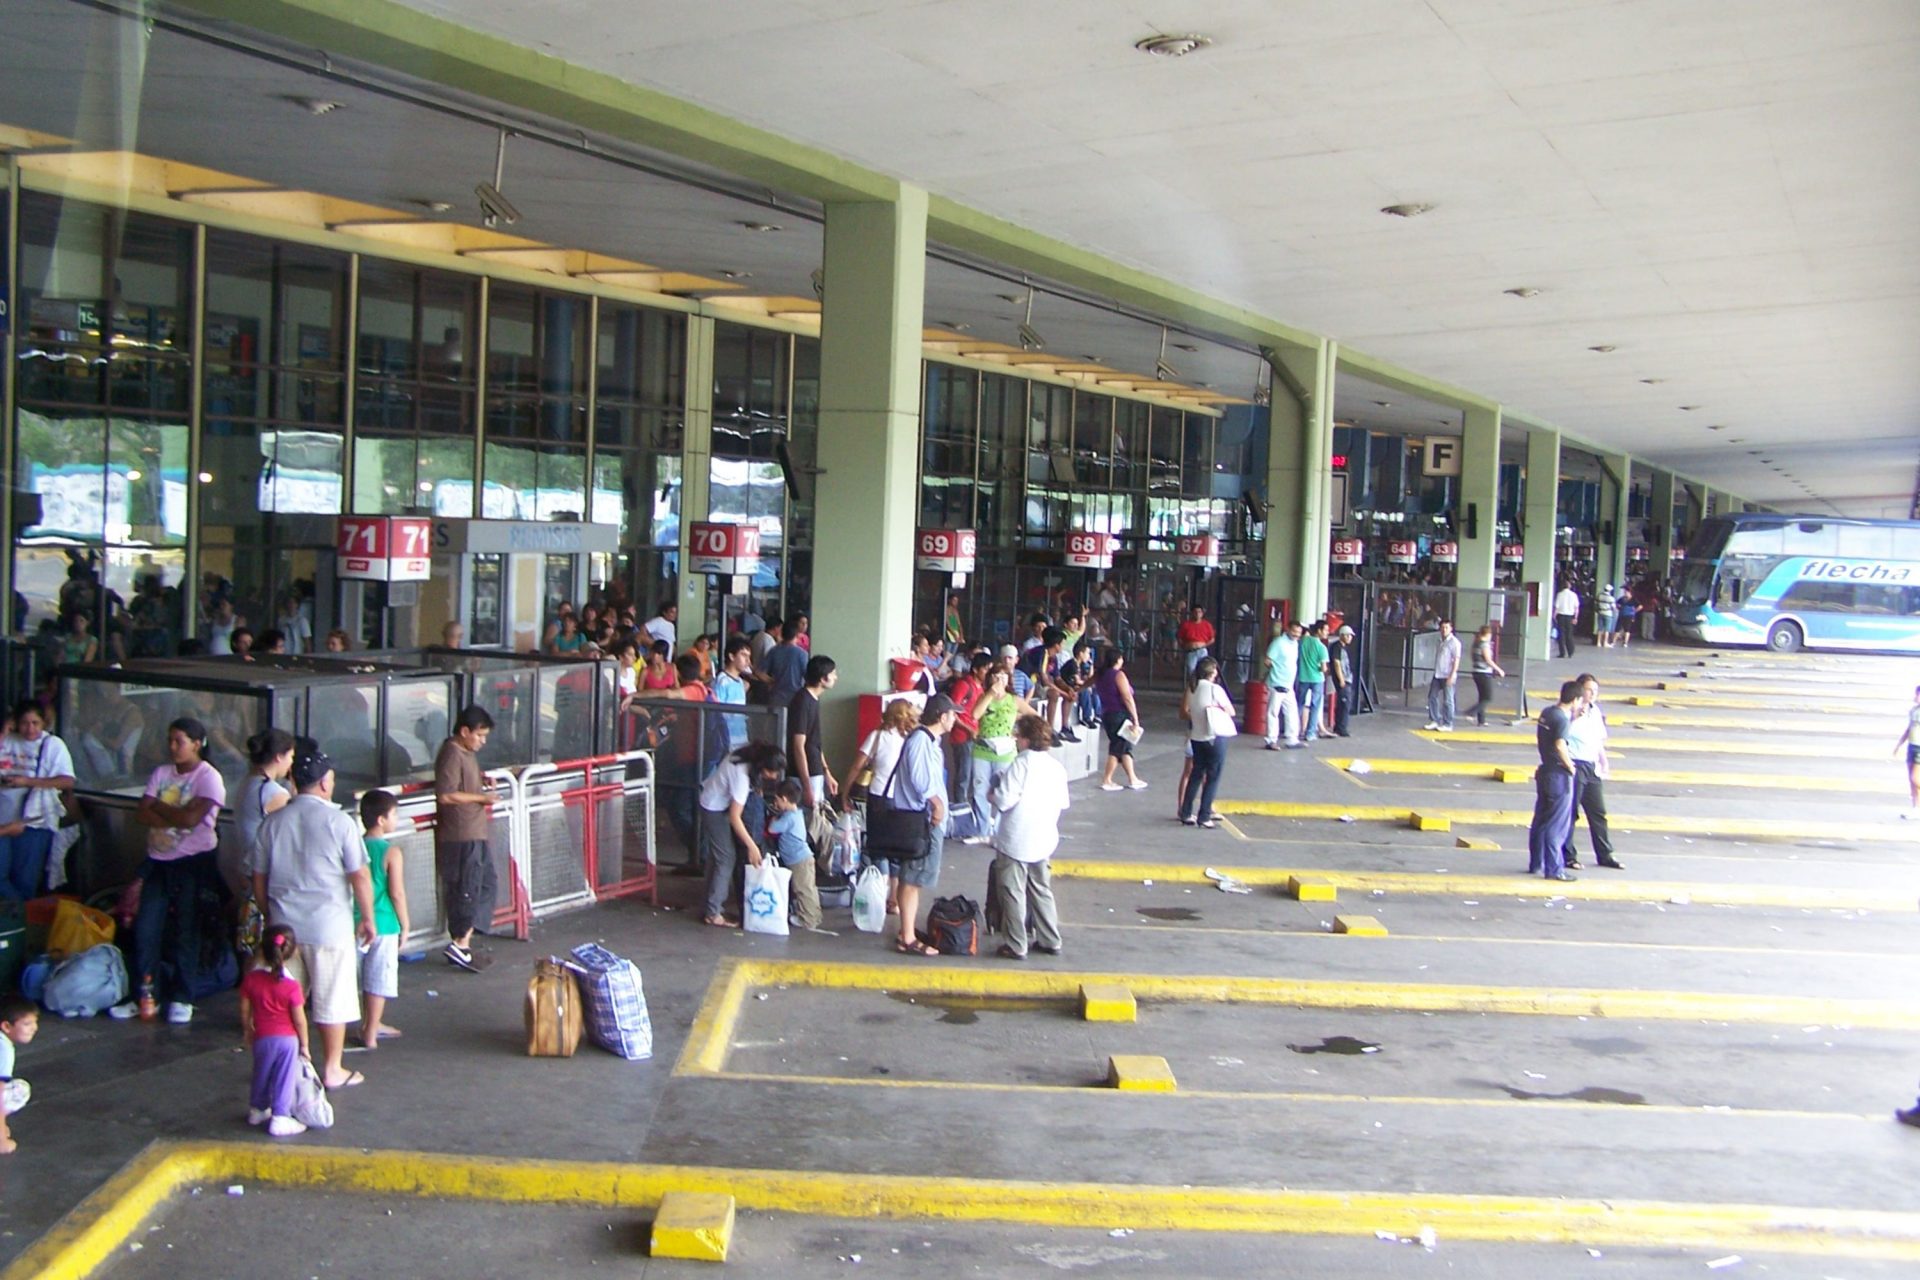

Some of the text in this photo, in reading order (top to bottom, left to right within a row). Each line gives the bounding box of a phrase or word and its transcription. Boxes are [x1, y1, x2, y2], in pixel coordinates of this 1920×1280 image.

[1433, 443, 1453, 468] F
[343, 524, 377, 553] 71
[402, 525, 430, 554] 71
[509, 525, 583, 548] REMISES
[695, 529, 727, 553] 70
[922, 534, 949, 554] 69
[1071, 536, 1096, 553] 68
[1181, 539, 1203, 553] 67
[1334, 542, 1352, 553] 65
[1391, 543, 1407, 554] 64
[1434, 544, 1449, 554] 63
[1802, 561, 1911, 580] flecha
